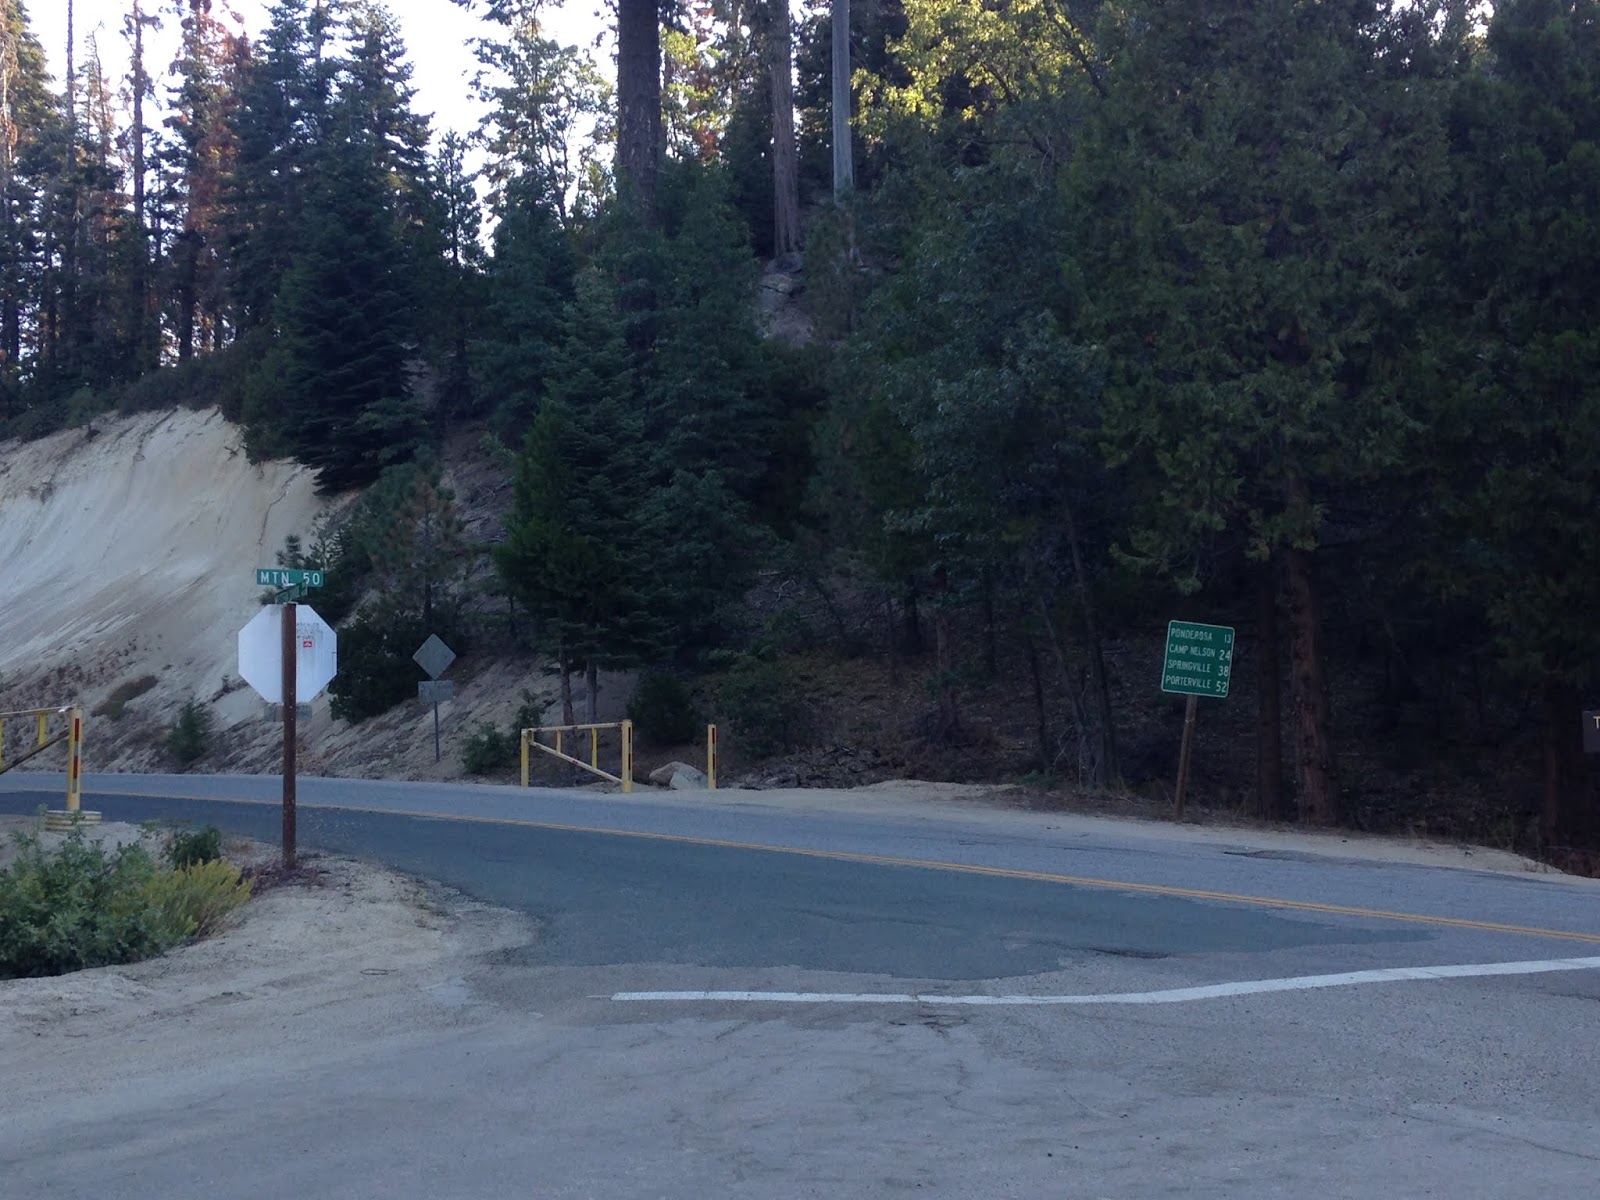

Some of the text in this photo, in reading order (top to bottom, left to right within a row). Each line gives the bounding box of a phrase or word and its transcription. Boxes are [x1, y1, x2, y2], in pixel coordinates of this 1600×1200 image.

[260, 571, 320, 585] MTN 50
[1170, 628, 1232, 644] PONDEROSA 13
[1169, 644, 1231, 660] CAMP NELSON 24
[1168, 659, 1230, 677] SPRINGVILLE 38
[1165, 675, 1227, 692] PORTERVILLE 52
